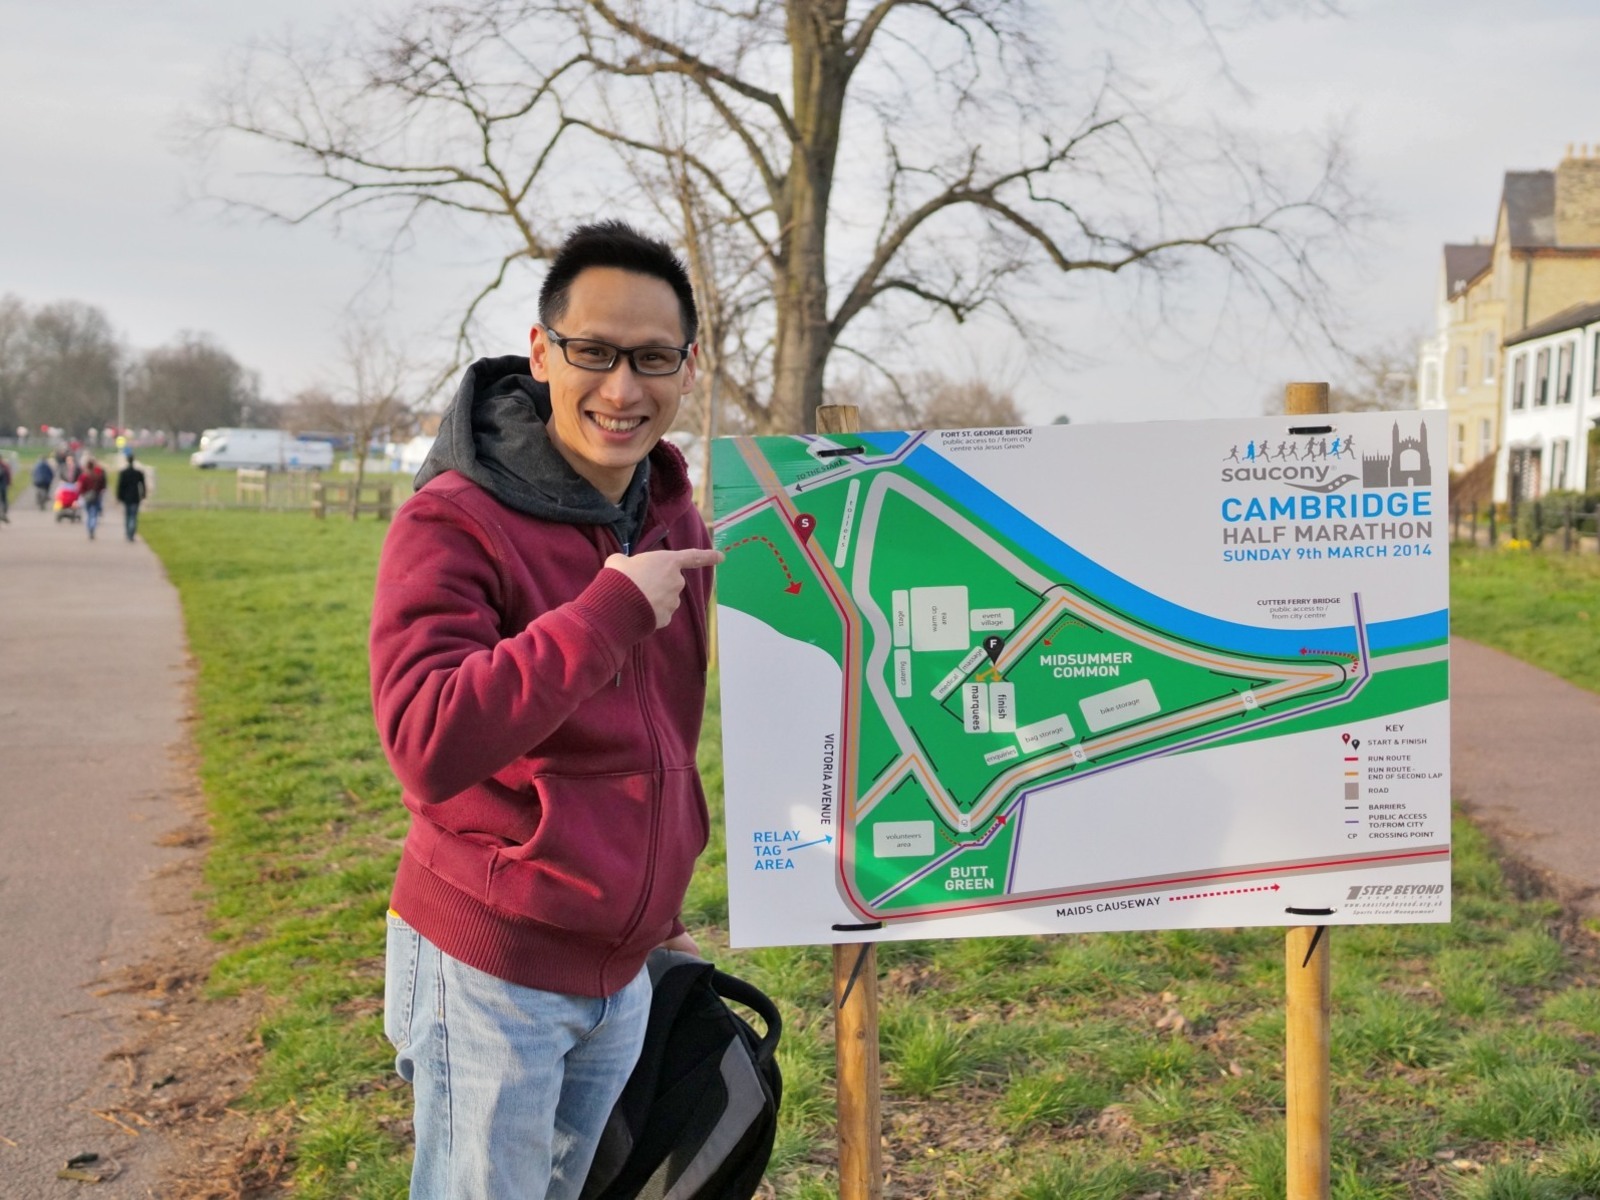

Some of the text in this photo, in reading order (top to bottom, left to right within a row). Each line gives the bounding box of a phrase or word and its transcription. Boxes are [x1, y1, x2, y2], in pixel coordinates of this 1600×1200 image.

[942, 438, 963, 446] public
[806, 469, 820, 477] THE
[821, 460, 842, 472] START
[1221, 465, 1330, 483] saucony
[1221, 491, 1432, 522] CAMBRIDGE
[801, 518, 809, 527] S
[1223, 521, 1432, 545] HALF MARATHON
[1223, 543, 1432, 562] SUNDAY 9th MARCH 2014
[981, 619, 1003, 627] village
[990, 639, 997, 648] F
[1040, 652, 1133, 666] MIDSUMMER
[1053, 665, 1119, 678] COMMON
[970, 685, 980, 731] marquees
[997, 693, 1007, 719] finish
[1116, 698, 1140, 711] storage
[1385, 724, 1404, 732] KEY
[820, 733, 835, 825] VICTORIA AVENUE
[754, 830, 801, 843] RELAY
[754, 845, 782, 857] TAG
[754, 858, 795, 870] AREA
[950, 865, 988, 878] BUTT
[945, 878, 994, 891] GREEN
[1393, 884, 1444, 895] BEYOND
[1056, 896, 1161, 917] MAIDS CAUSEWAY
